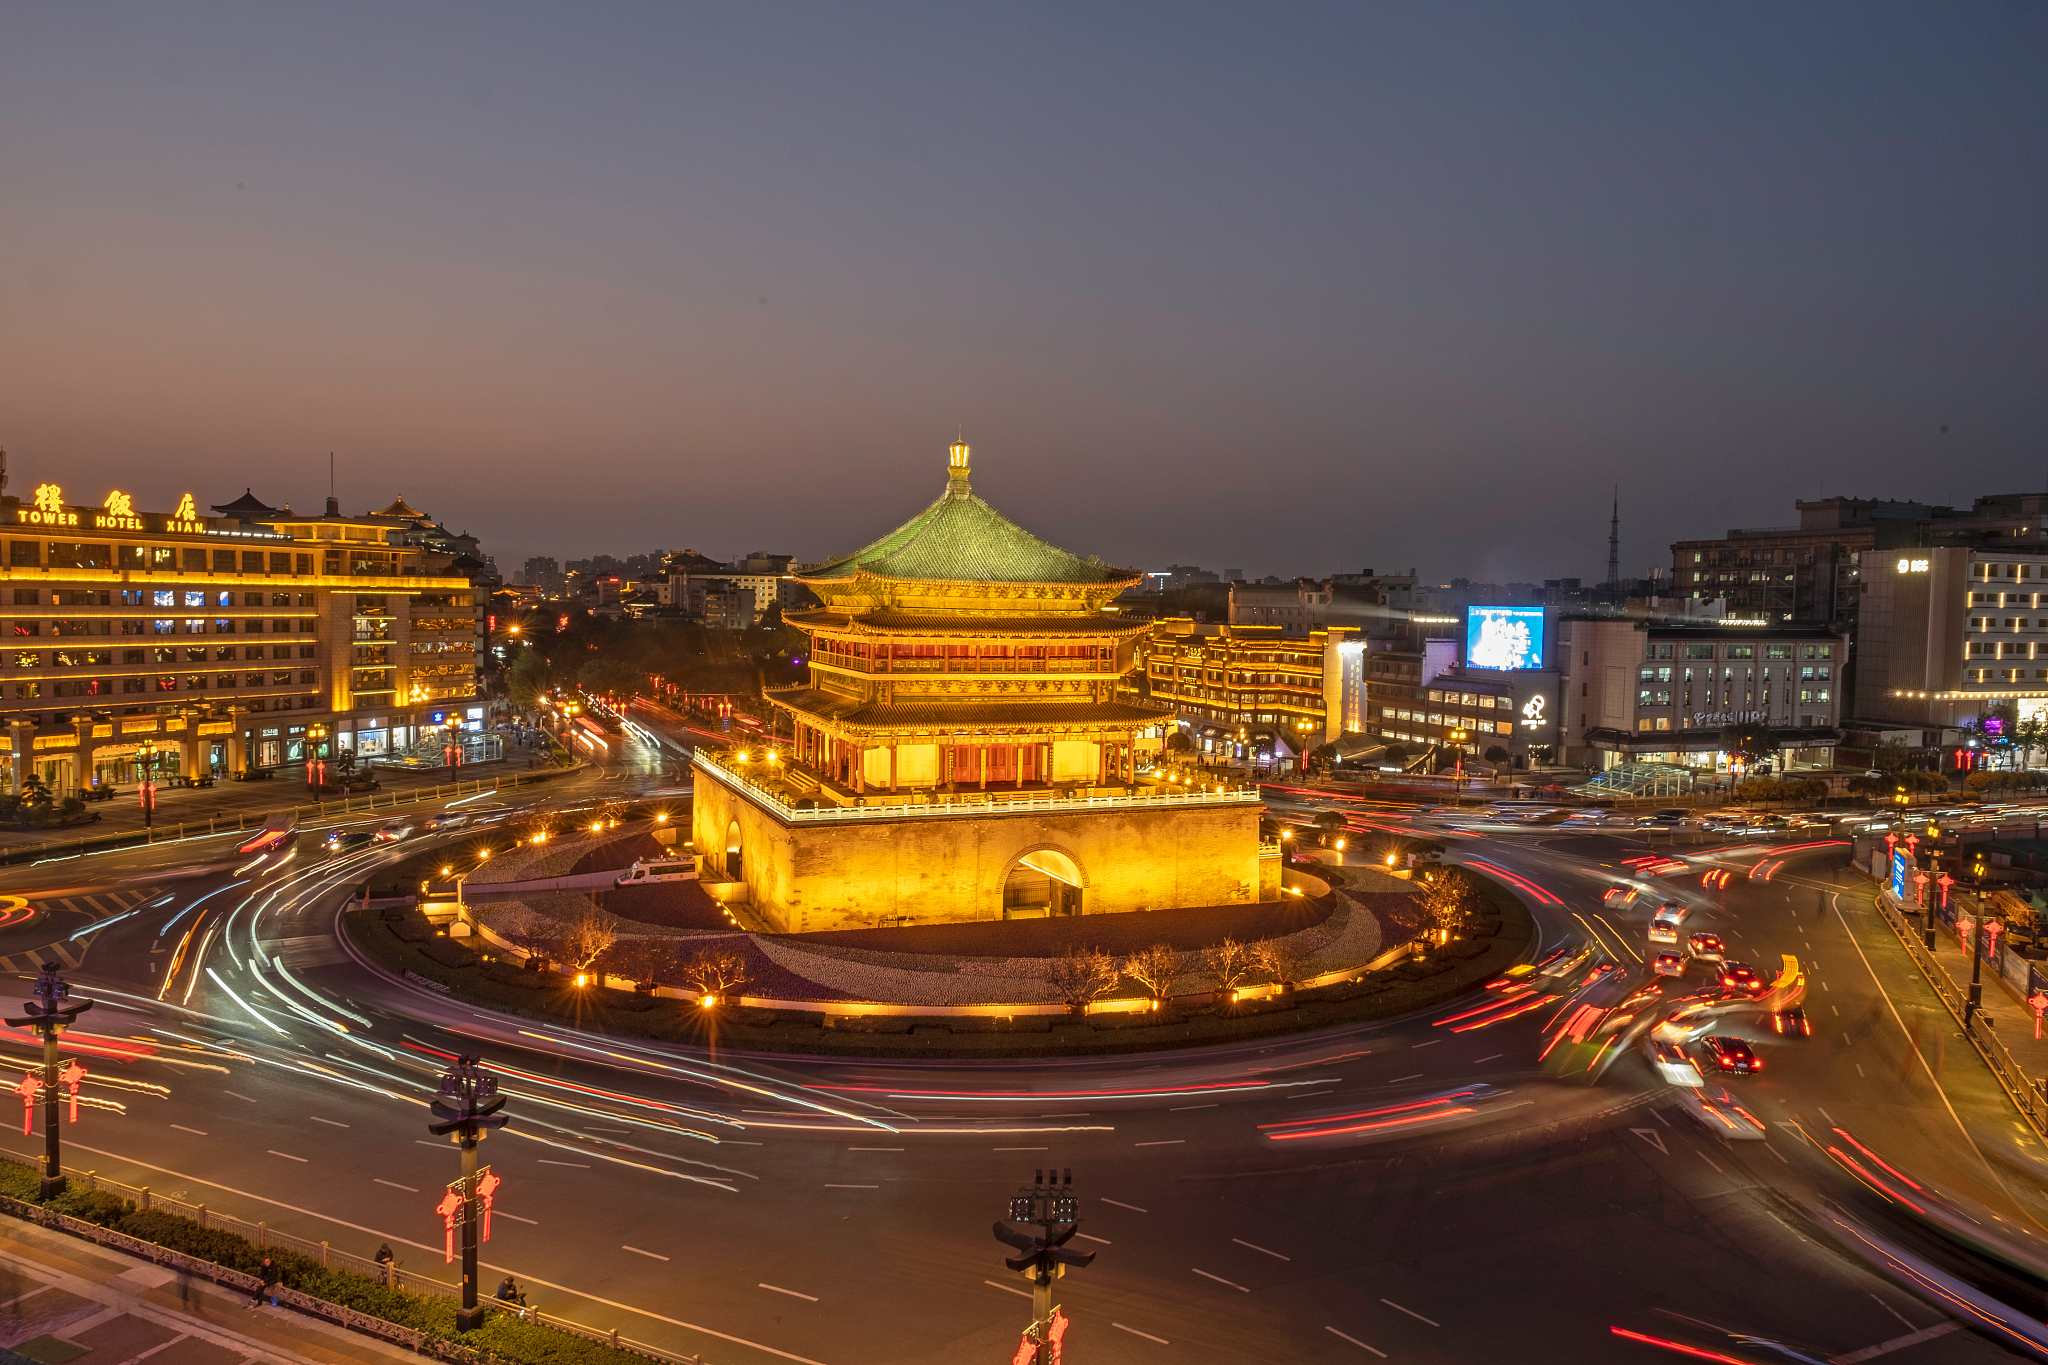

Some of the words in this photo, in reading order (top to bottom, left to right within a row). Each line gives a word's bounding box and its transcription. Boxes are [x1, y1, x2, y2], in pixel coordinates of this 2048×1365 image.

[17, 510, 78, 525] TOWER
[95, 515, 143, 530] HOTEL
[166, 520, 204, 534] XIAN
